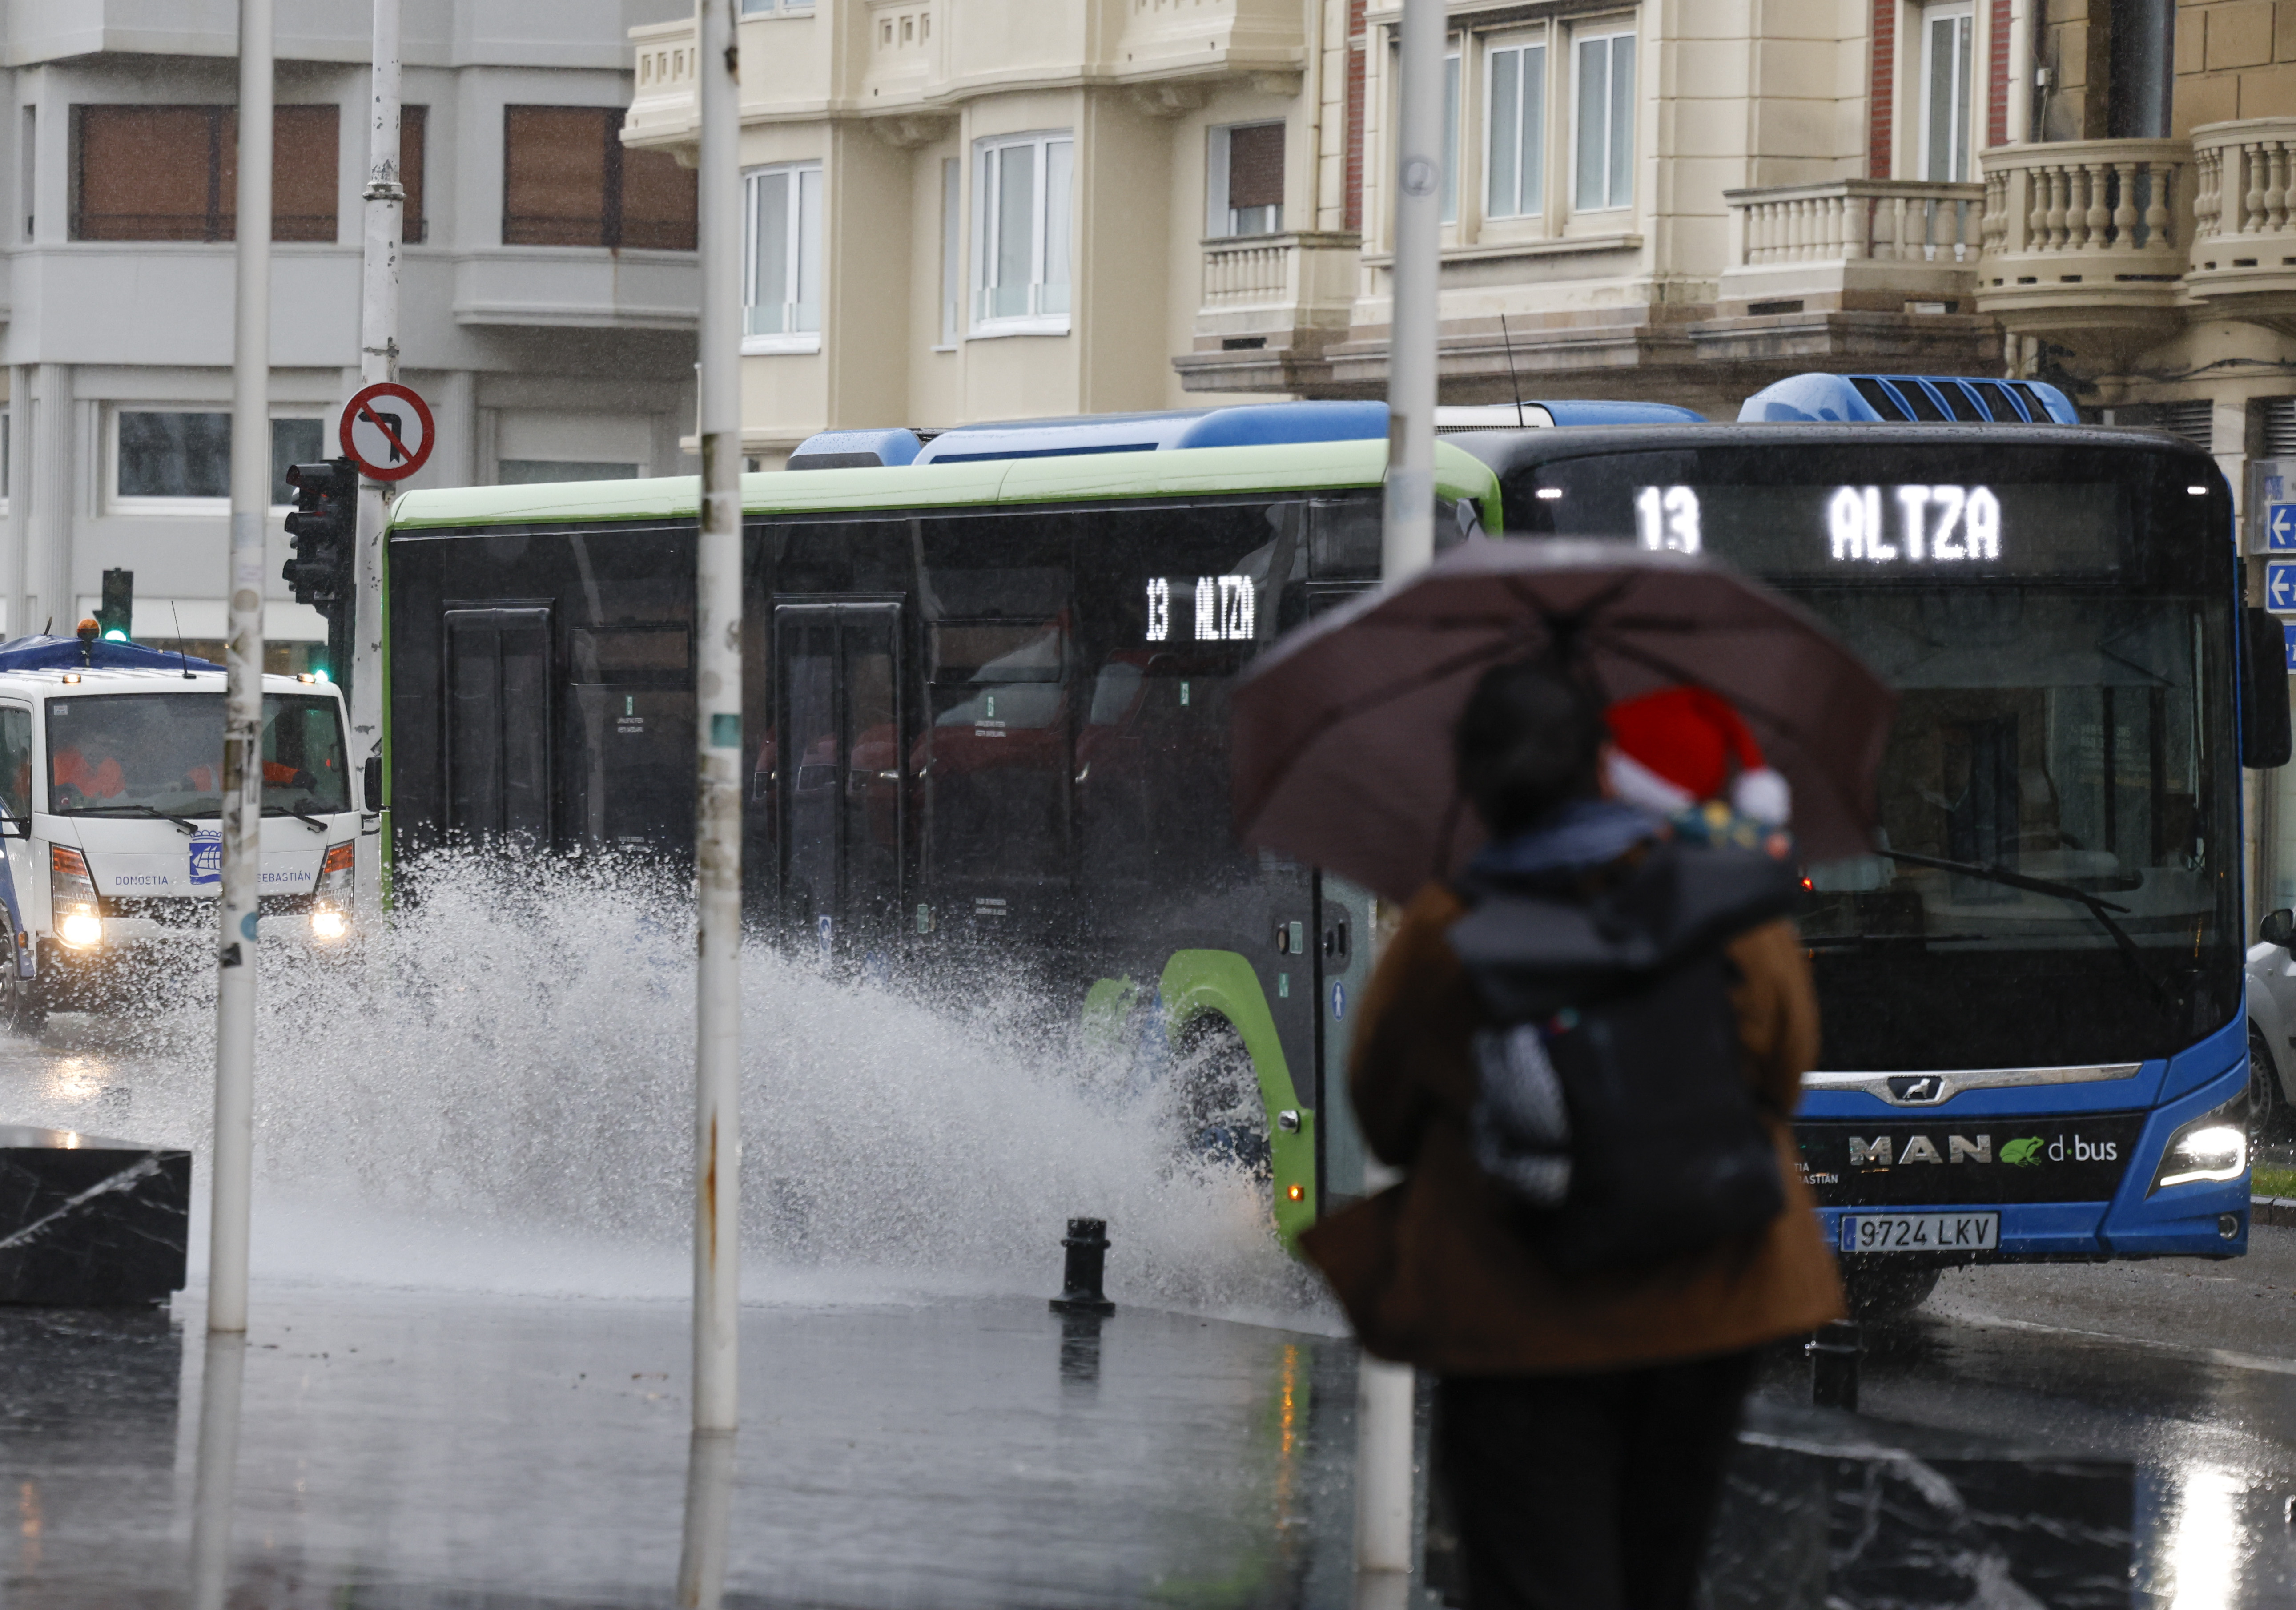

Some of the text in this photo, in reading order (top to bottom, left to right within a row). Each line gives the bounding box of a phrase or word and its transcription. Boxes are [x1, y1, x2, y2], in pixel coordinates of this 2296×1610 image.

[1637, 485, 2002, 562] 13 ALTZA
[1146, 576, 1255, 640] 13 ALTZA
[115, 876, 169, 886] DONOSTIA
[1849, 1135, 1992, 1166] MAN
[1861, 1218, 1989, 1247] 9724 LKV
